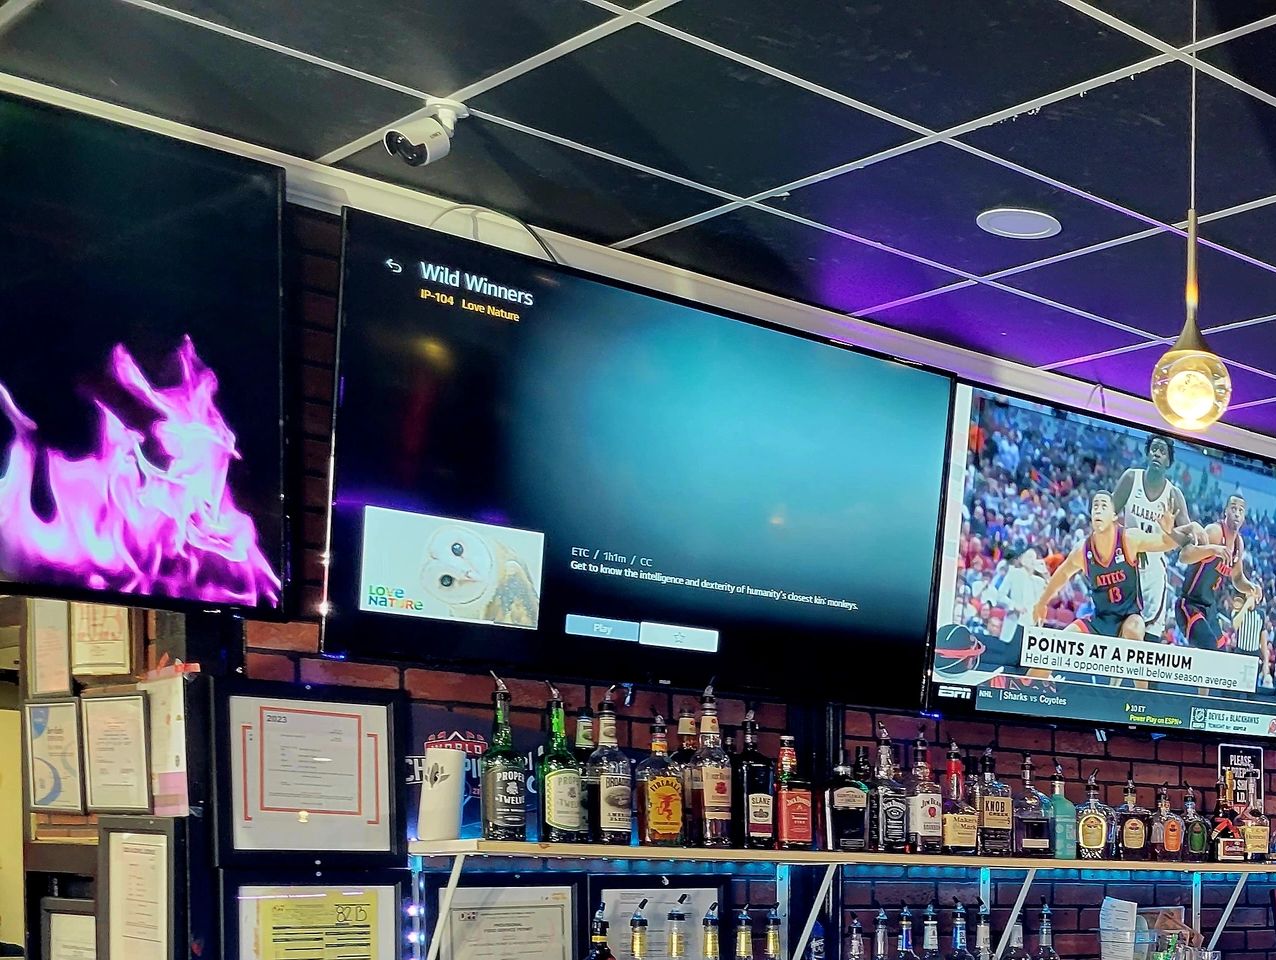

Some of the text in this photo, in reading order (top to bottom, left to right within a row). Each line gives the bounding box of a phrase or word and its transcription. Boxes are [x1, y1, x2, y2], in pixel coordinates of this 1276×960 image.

[420, 262, 535, 306] Wild Winners
[420, 288, 520, 322] IP-104 Love Nature
[571, 546, 590, 558] ETC
[602, 552, 627, 564] 1h1m
[640, 557, 653, 567] CC
[570, 560, 587, 571] Get
[588, 563, 598, 573] to
[600, 564, 623, 576] know
[624, 567, 639, 579] the
[640, 570, 685, 585] intelligence
[685, 578, 700, 588] and
[700, 580, 736, 594] dexterity
[736, 584, 746, 594] of
[747, 585, 787, 600] humanity's
[787, 592, 814, 603] closest
[1096, 569, 1126, 586] AZTECS
[1108, 586, 1122, 603] 13
[593, 623, 613, 635] Play
[1027, 635, 1193, 670] POINTS AT A PREMIUM
[1025, 653, 1238, 688] Held all 4 opponents well below season average
[937, 685, 972, 700] ESPN
[1003, 691, 1028, 702] Sharks
[1039, 695, 1067, 706] Coyotes
[266, 714, 288, 724] 2023
[1229, 754, 1252, 767] PLEASE
[650, 779, 681, 792] FIREBALL
[751, 796, 771, 806] SLANE
[985, 800, 1006, 813] KNOB
